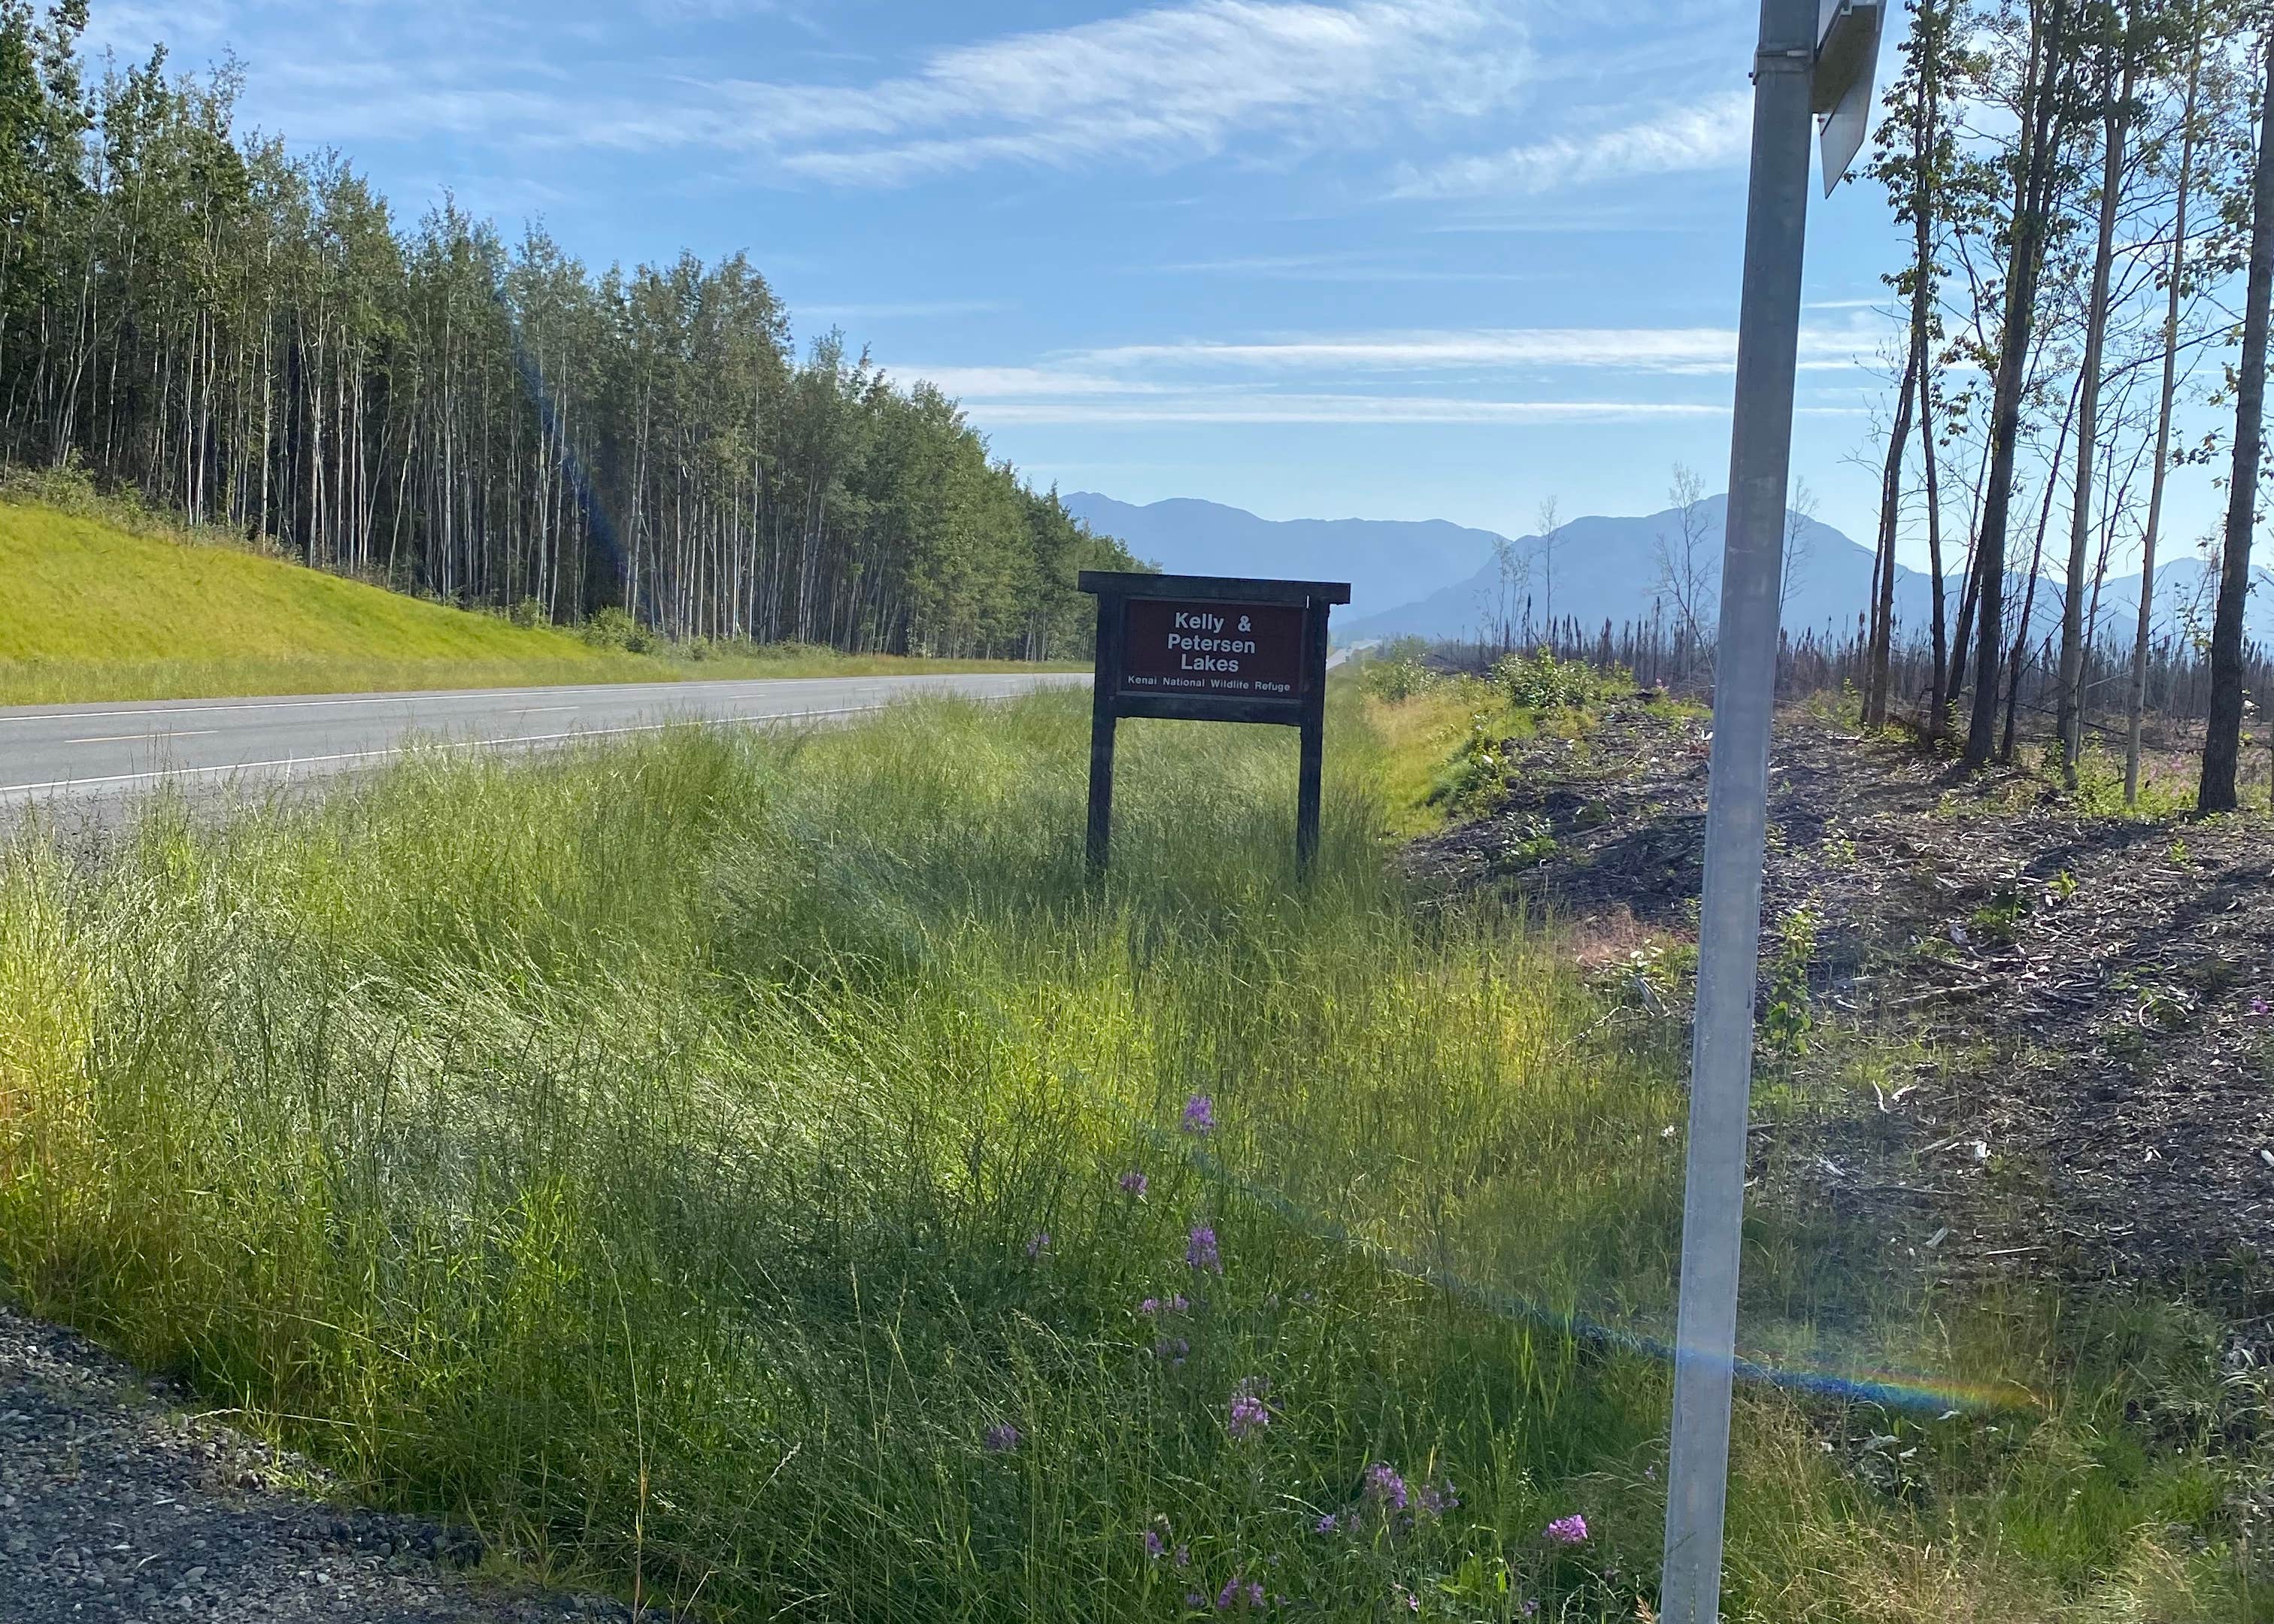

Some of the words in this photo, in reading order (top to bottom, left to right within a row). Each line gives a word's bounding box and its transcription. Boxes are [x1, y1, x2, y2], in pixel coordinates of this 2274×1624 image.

[1175, 612, 1225, 633] Kelly
[1237, 615, 1251, 632] &
[1168, 633, 1256, 653] Petersen
[1181, 653, 1239, 672] Lakes
[1128, 675, 1157, 685] Kenai
[1163, 677, 1205, 687] National
[1211, 679, 1249, 689] Wildlife
[1255, 681, 1290, 692] Refuge
